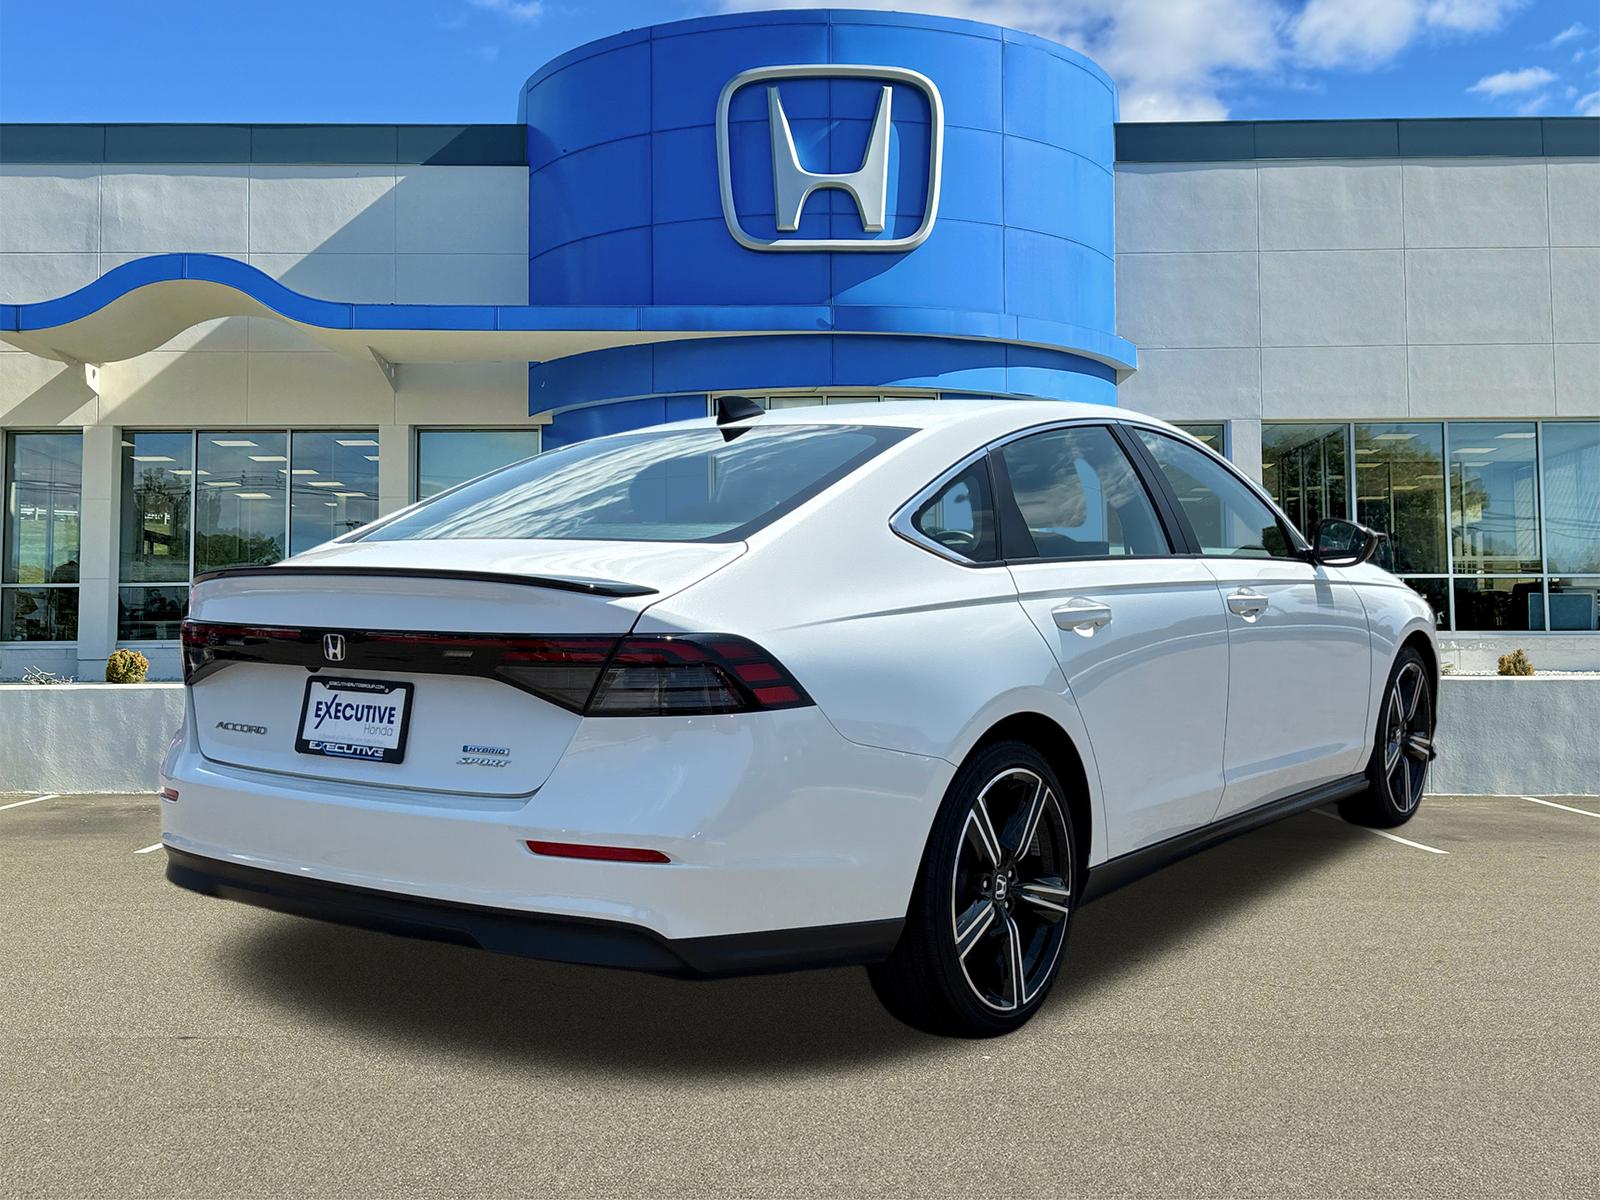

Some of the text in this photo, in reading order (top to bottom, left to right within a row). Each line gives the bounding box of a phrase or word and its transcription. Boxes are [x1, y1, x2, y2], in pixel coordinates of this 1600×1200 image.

[314, 694, 397, 729] EXECUTIVE
[215, 721, 267, 735] ACCORD
[363, 723, 393, 737] Honda
[308, 740, 385, 758] EXECUTIVE
[466, 746, 507, 755] HYBRID
[456, 757, 511, 768] SPORT
